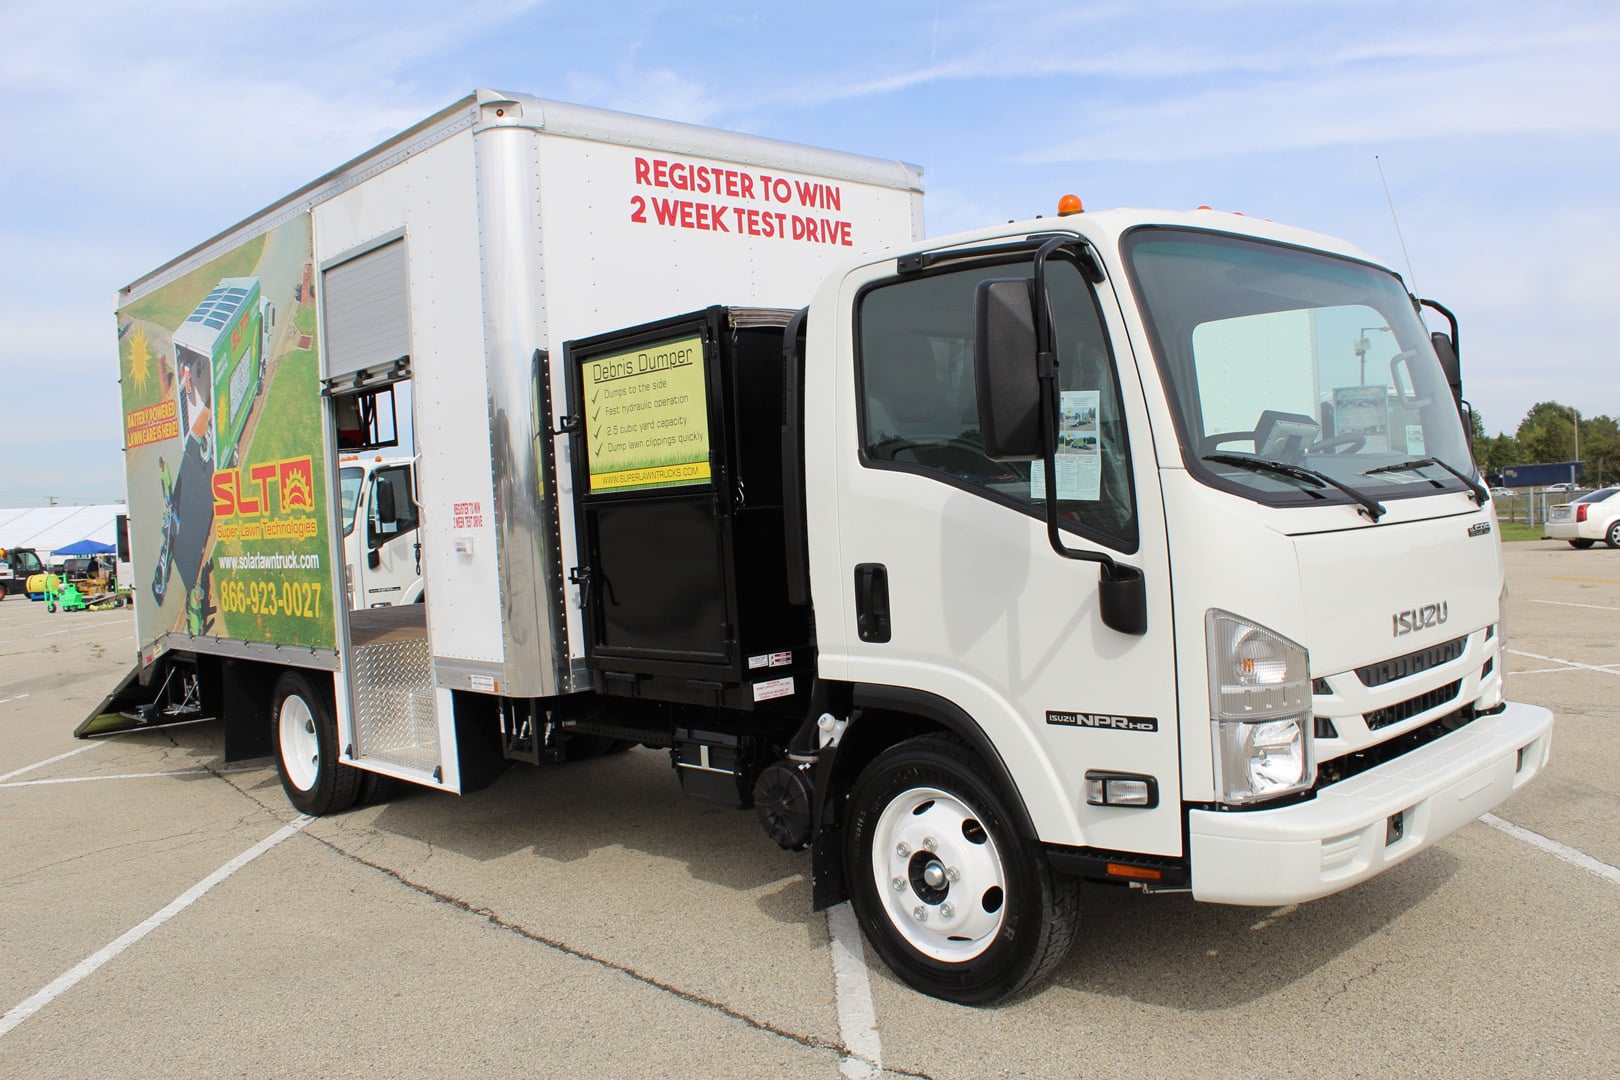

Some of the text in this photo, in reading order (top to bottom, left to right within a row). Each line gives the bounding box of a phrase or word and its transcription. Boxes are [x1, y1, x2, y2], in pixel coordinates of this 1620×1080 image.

[634, 157, 841, 211] REGISTER TO WIN
[630, 195, 853, 246] 2 WEEK TEST DRIVE
[592, 348, 693, 382] Debris Dumper
[604, 379, 668, 400] Dumps to the side
[127, 401, 176, 428] BATTERY POWERED
[605, 394, 689, 416] Fast hydraulic operation
[127, 429, 143, 447] LAWN
[143, 426, 157, 443] CARE
[606, 415, 688, 436] 2.5 cubic yard capacity
[607, 431, 704, 454] Dump lawn clippings quickly
[602, 466, 700, 485] WWW.SUPERLAWNTRUCKS.COM
[213, 464, 277, 517] SLT
[216, 519, 316, 540] Super Lawn Technologies
[218, 550, 320, 569] www.solarlawntruck.com
[220, 580, 321, 618] 866-923-0027
[1392, 600, 1448, 638] ISUZU
[1049, 714, 1076, 723] ISUZU
